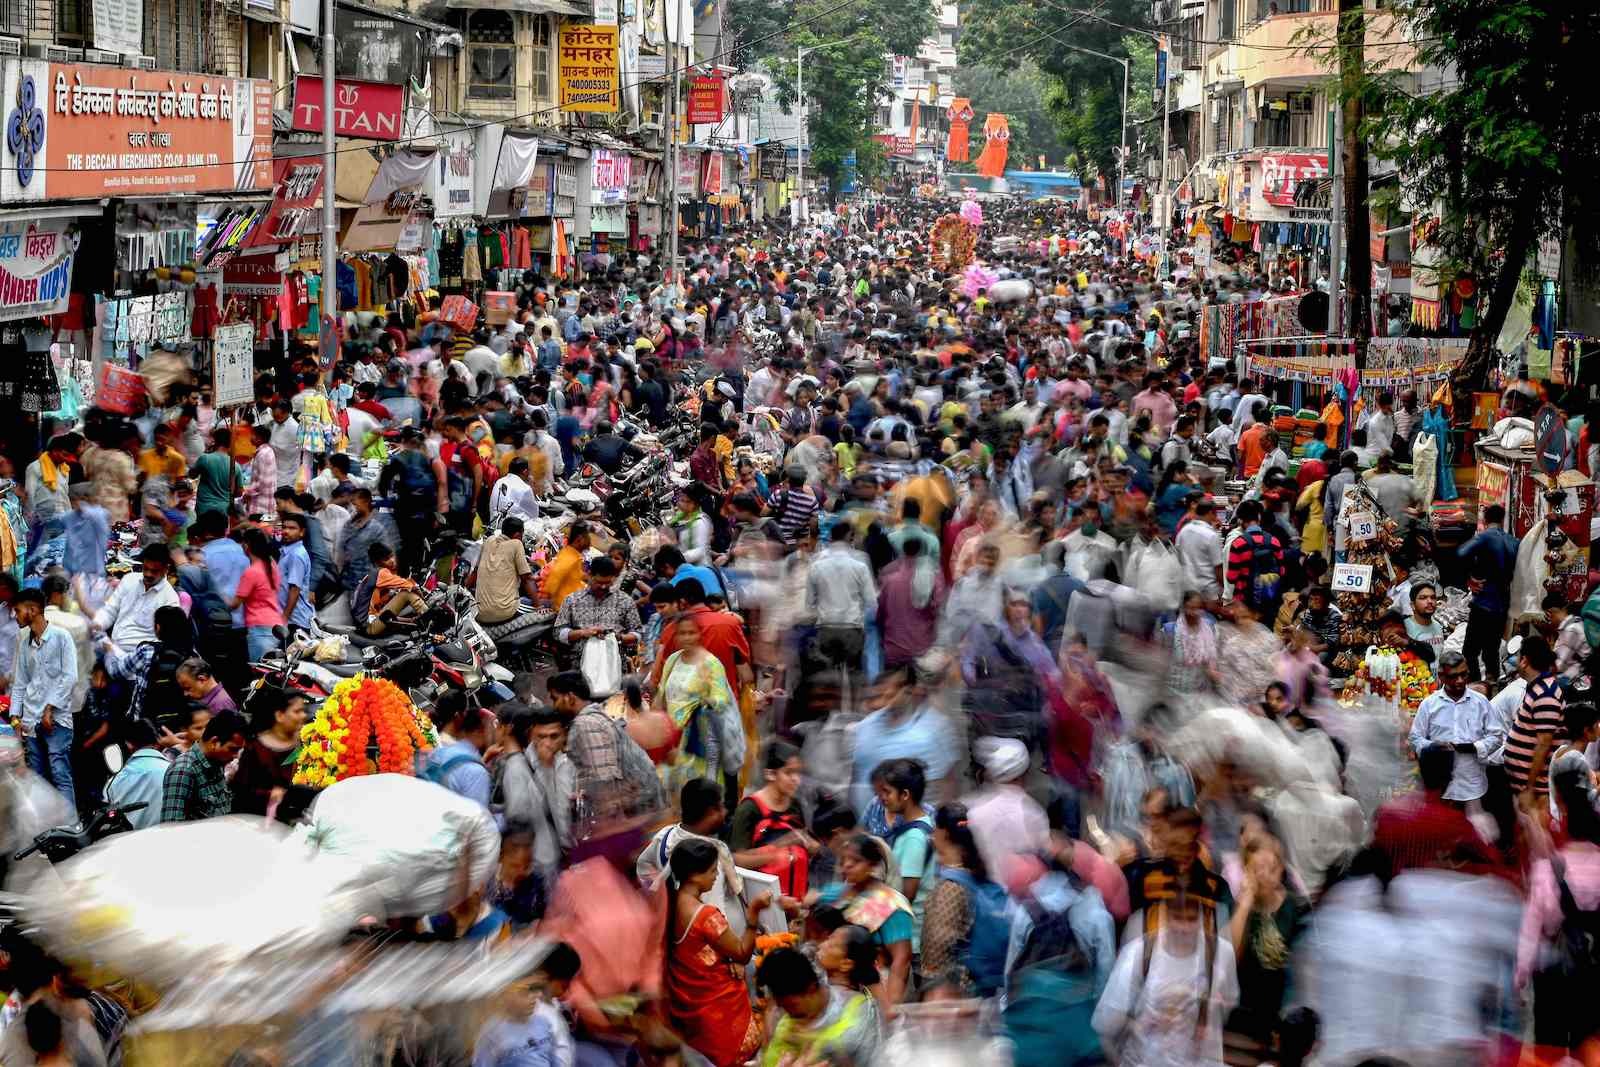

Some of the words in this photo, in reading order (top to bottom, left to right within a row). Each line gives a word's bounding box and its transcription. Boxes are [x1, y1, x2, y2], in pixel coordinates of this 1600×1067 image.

[562, 27, 615, 46] हॉटेल
[561, 46, 614, 64] मनहर
[72, 71, 115, 115] डेक्कन
[297, 104, 397, 133] TTAN
[66, 153, 83, 170] THE
[85, 153, 117, 169] DECCAN
[119, 153, 162, 168] MERCHANTS
[187, 153, 205, 168] BANK
[233, 264, 276, 273] TITAN
[1360, 523, 1371, 535] 50
[1346, 575, 1363, 587] 50
